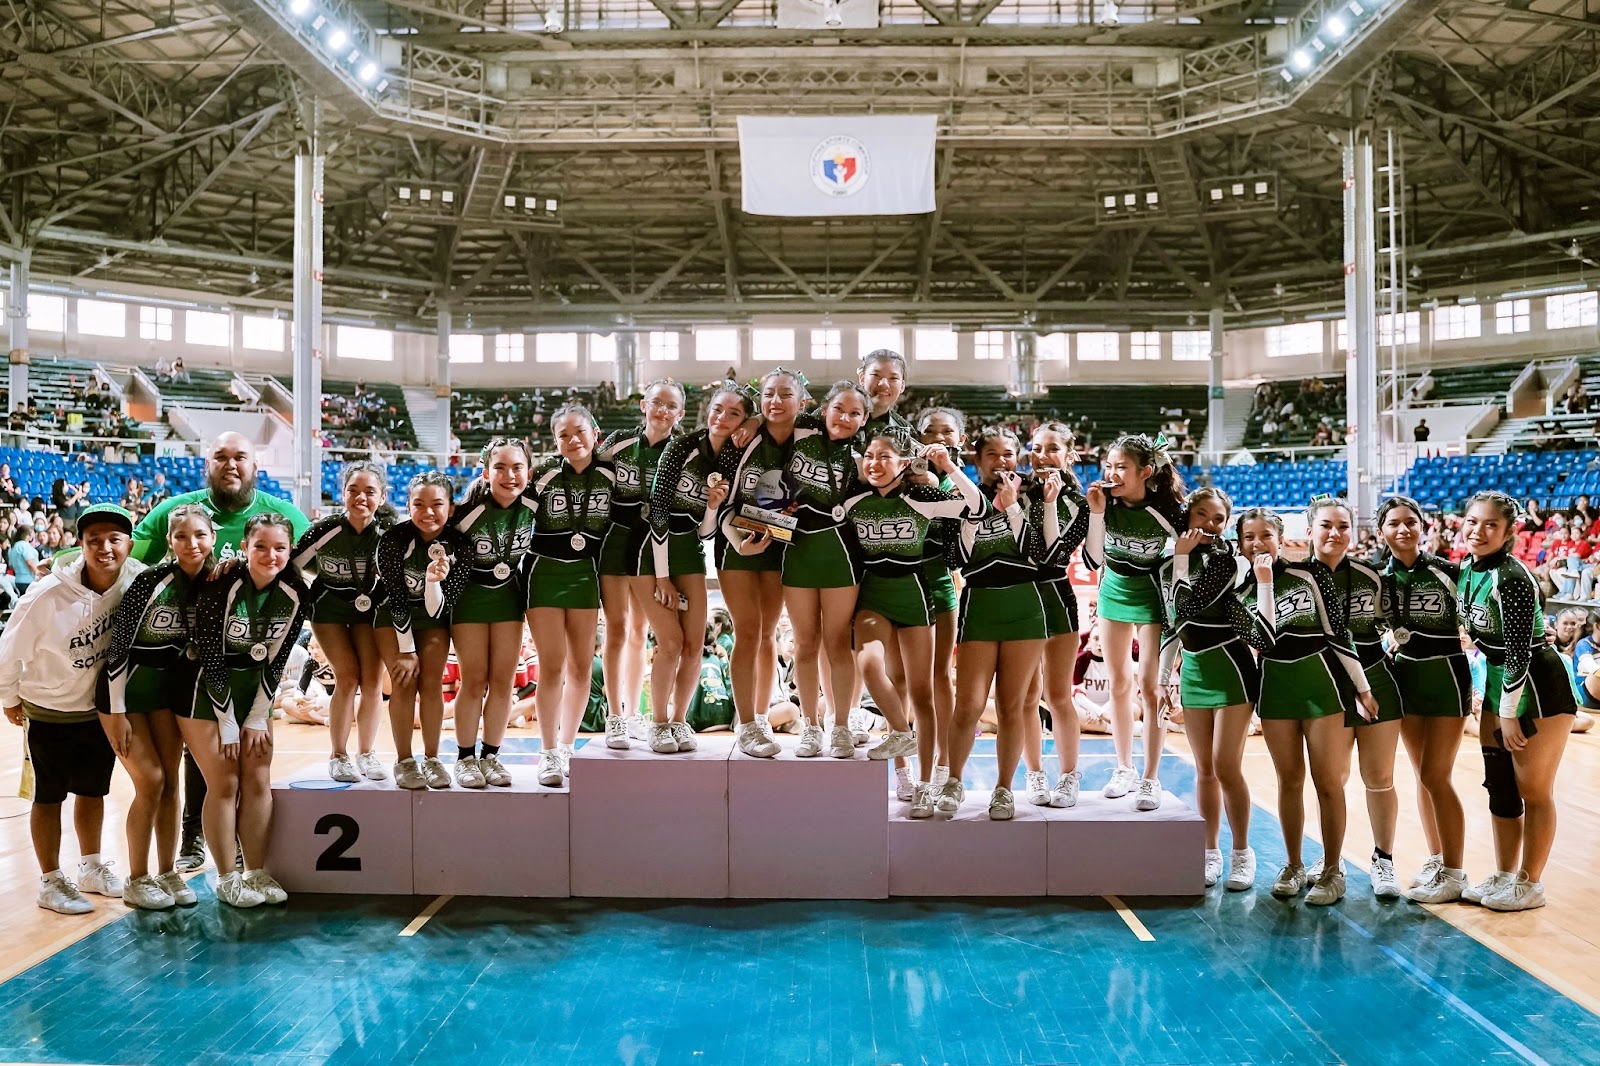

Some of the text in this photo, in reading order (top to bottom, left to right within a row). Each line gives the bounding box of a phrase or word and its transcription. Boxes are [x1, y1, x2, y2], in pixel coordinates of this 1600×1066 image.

[855, 521, 915, 540] DLSZ
[1084, 679, 1110, 691] PW
[314, 813, 362, 872] 2
